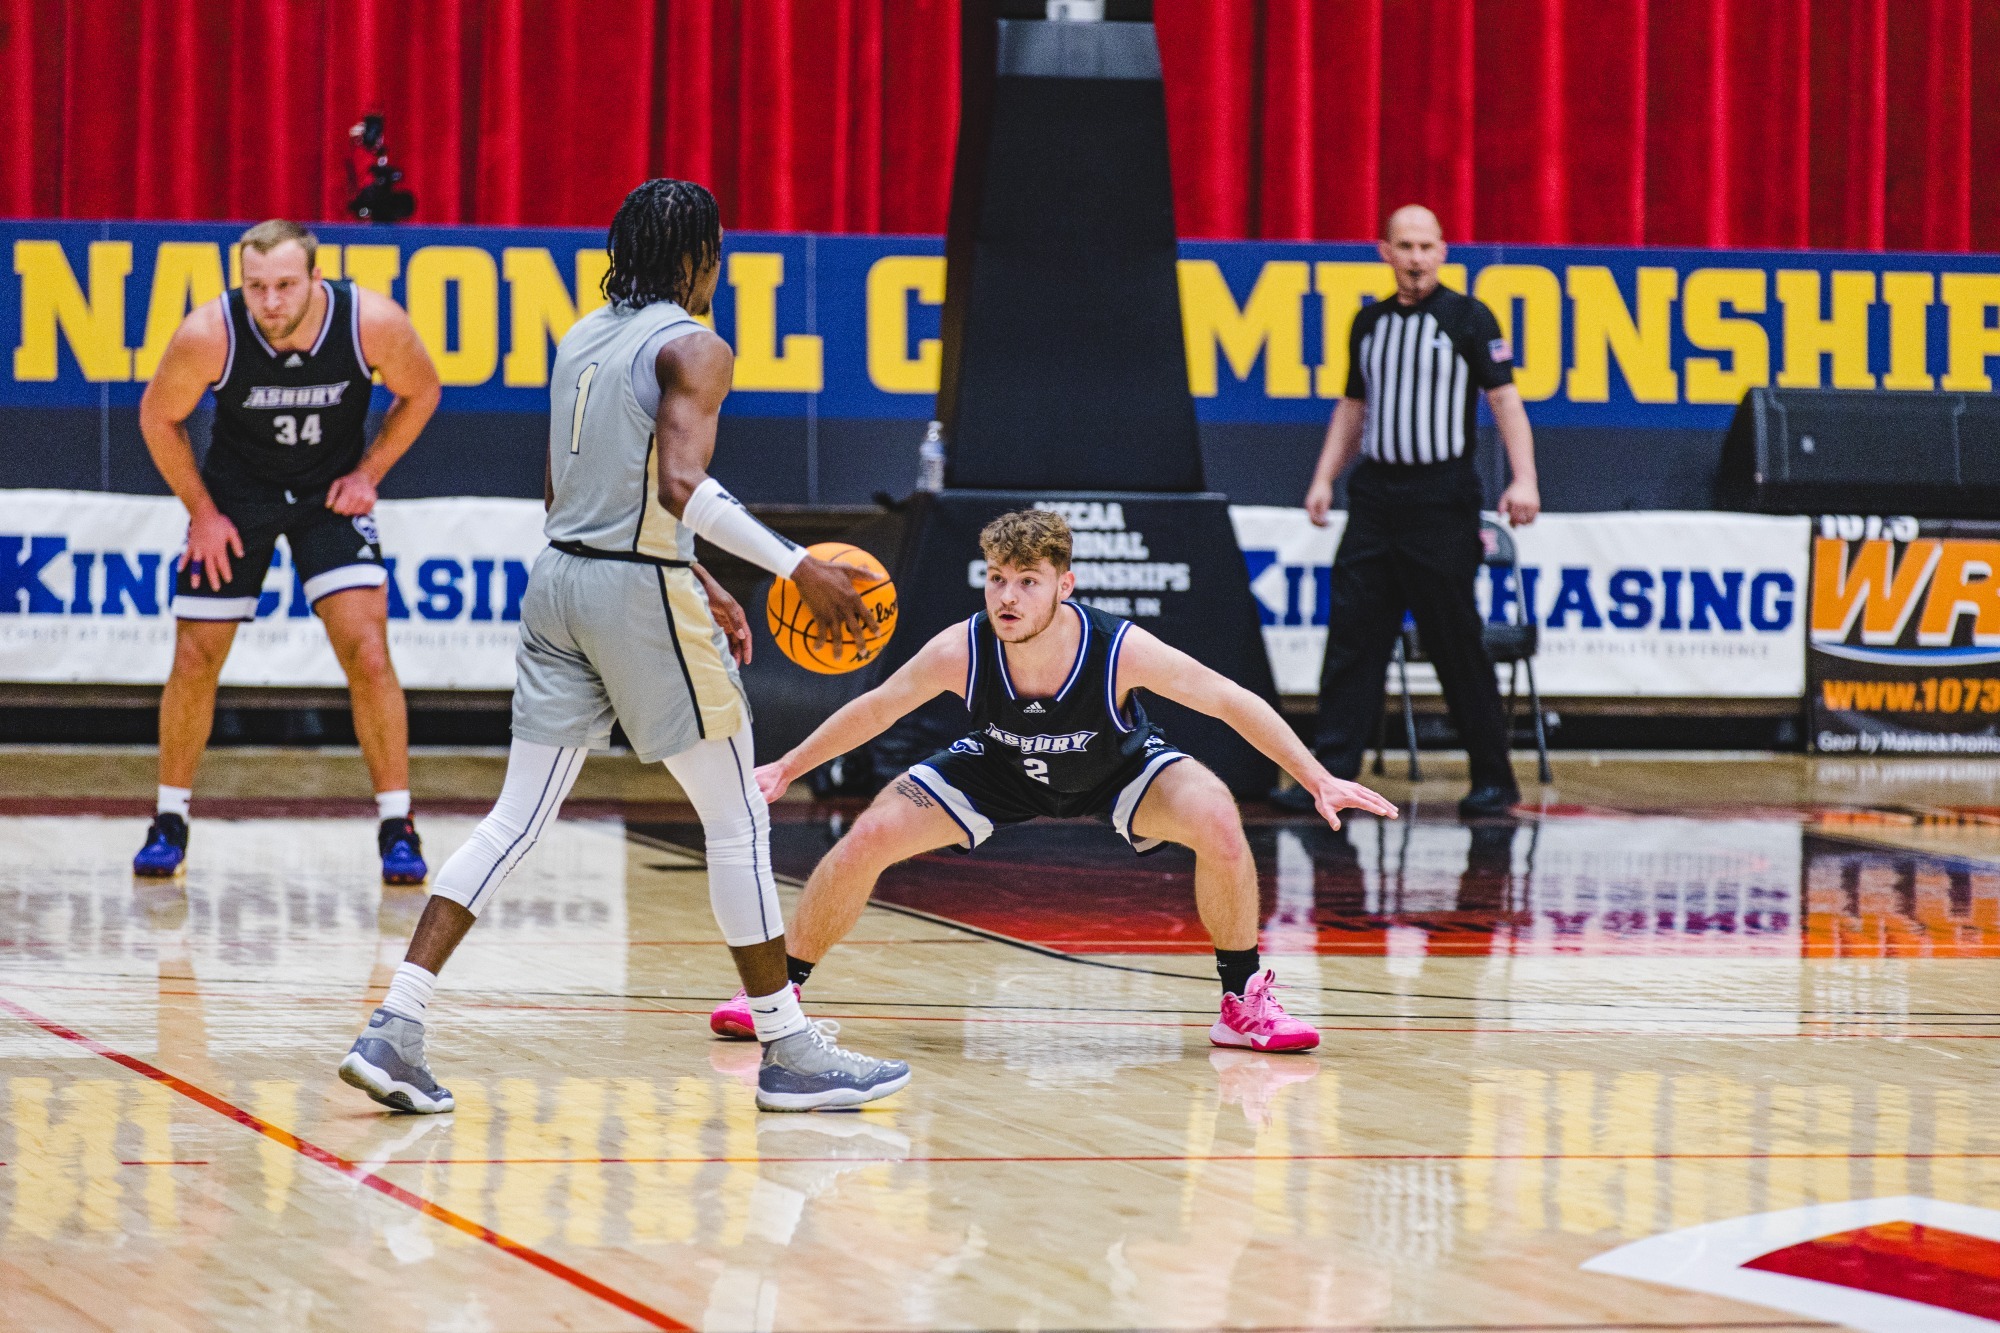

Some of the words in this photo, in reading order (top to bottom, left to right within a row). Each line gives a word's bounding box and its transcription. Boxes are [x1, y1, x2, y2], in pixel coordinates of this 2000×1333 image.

[13, 240, 824, 393] NAONL
[248, 381, 345, 408] ASBURY
[570, 362, 599, 455] 1
[273, 413, 323, 446] 34
[1034, 501, 1126, 530] CCAA
[988, 728, 1085, 754] ASBURY
[1023, 757, 1050, 785] 2
